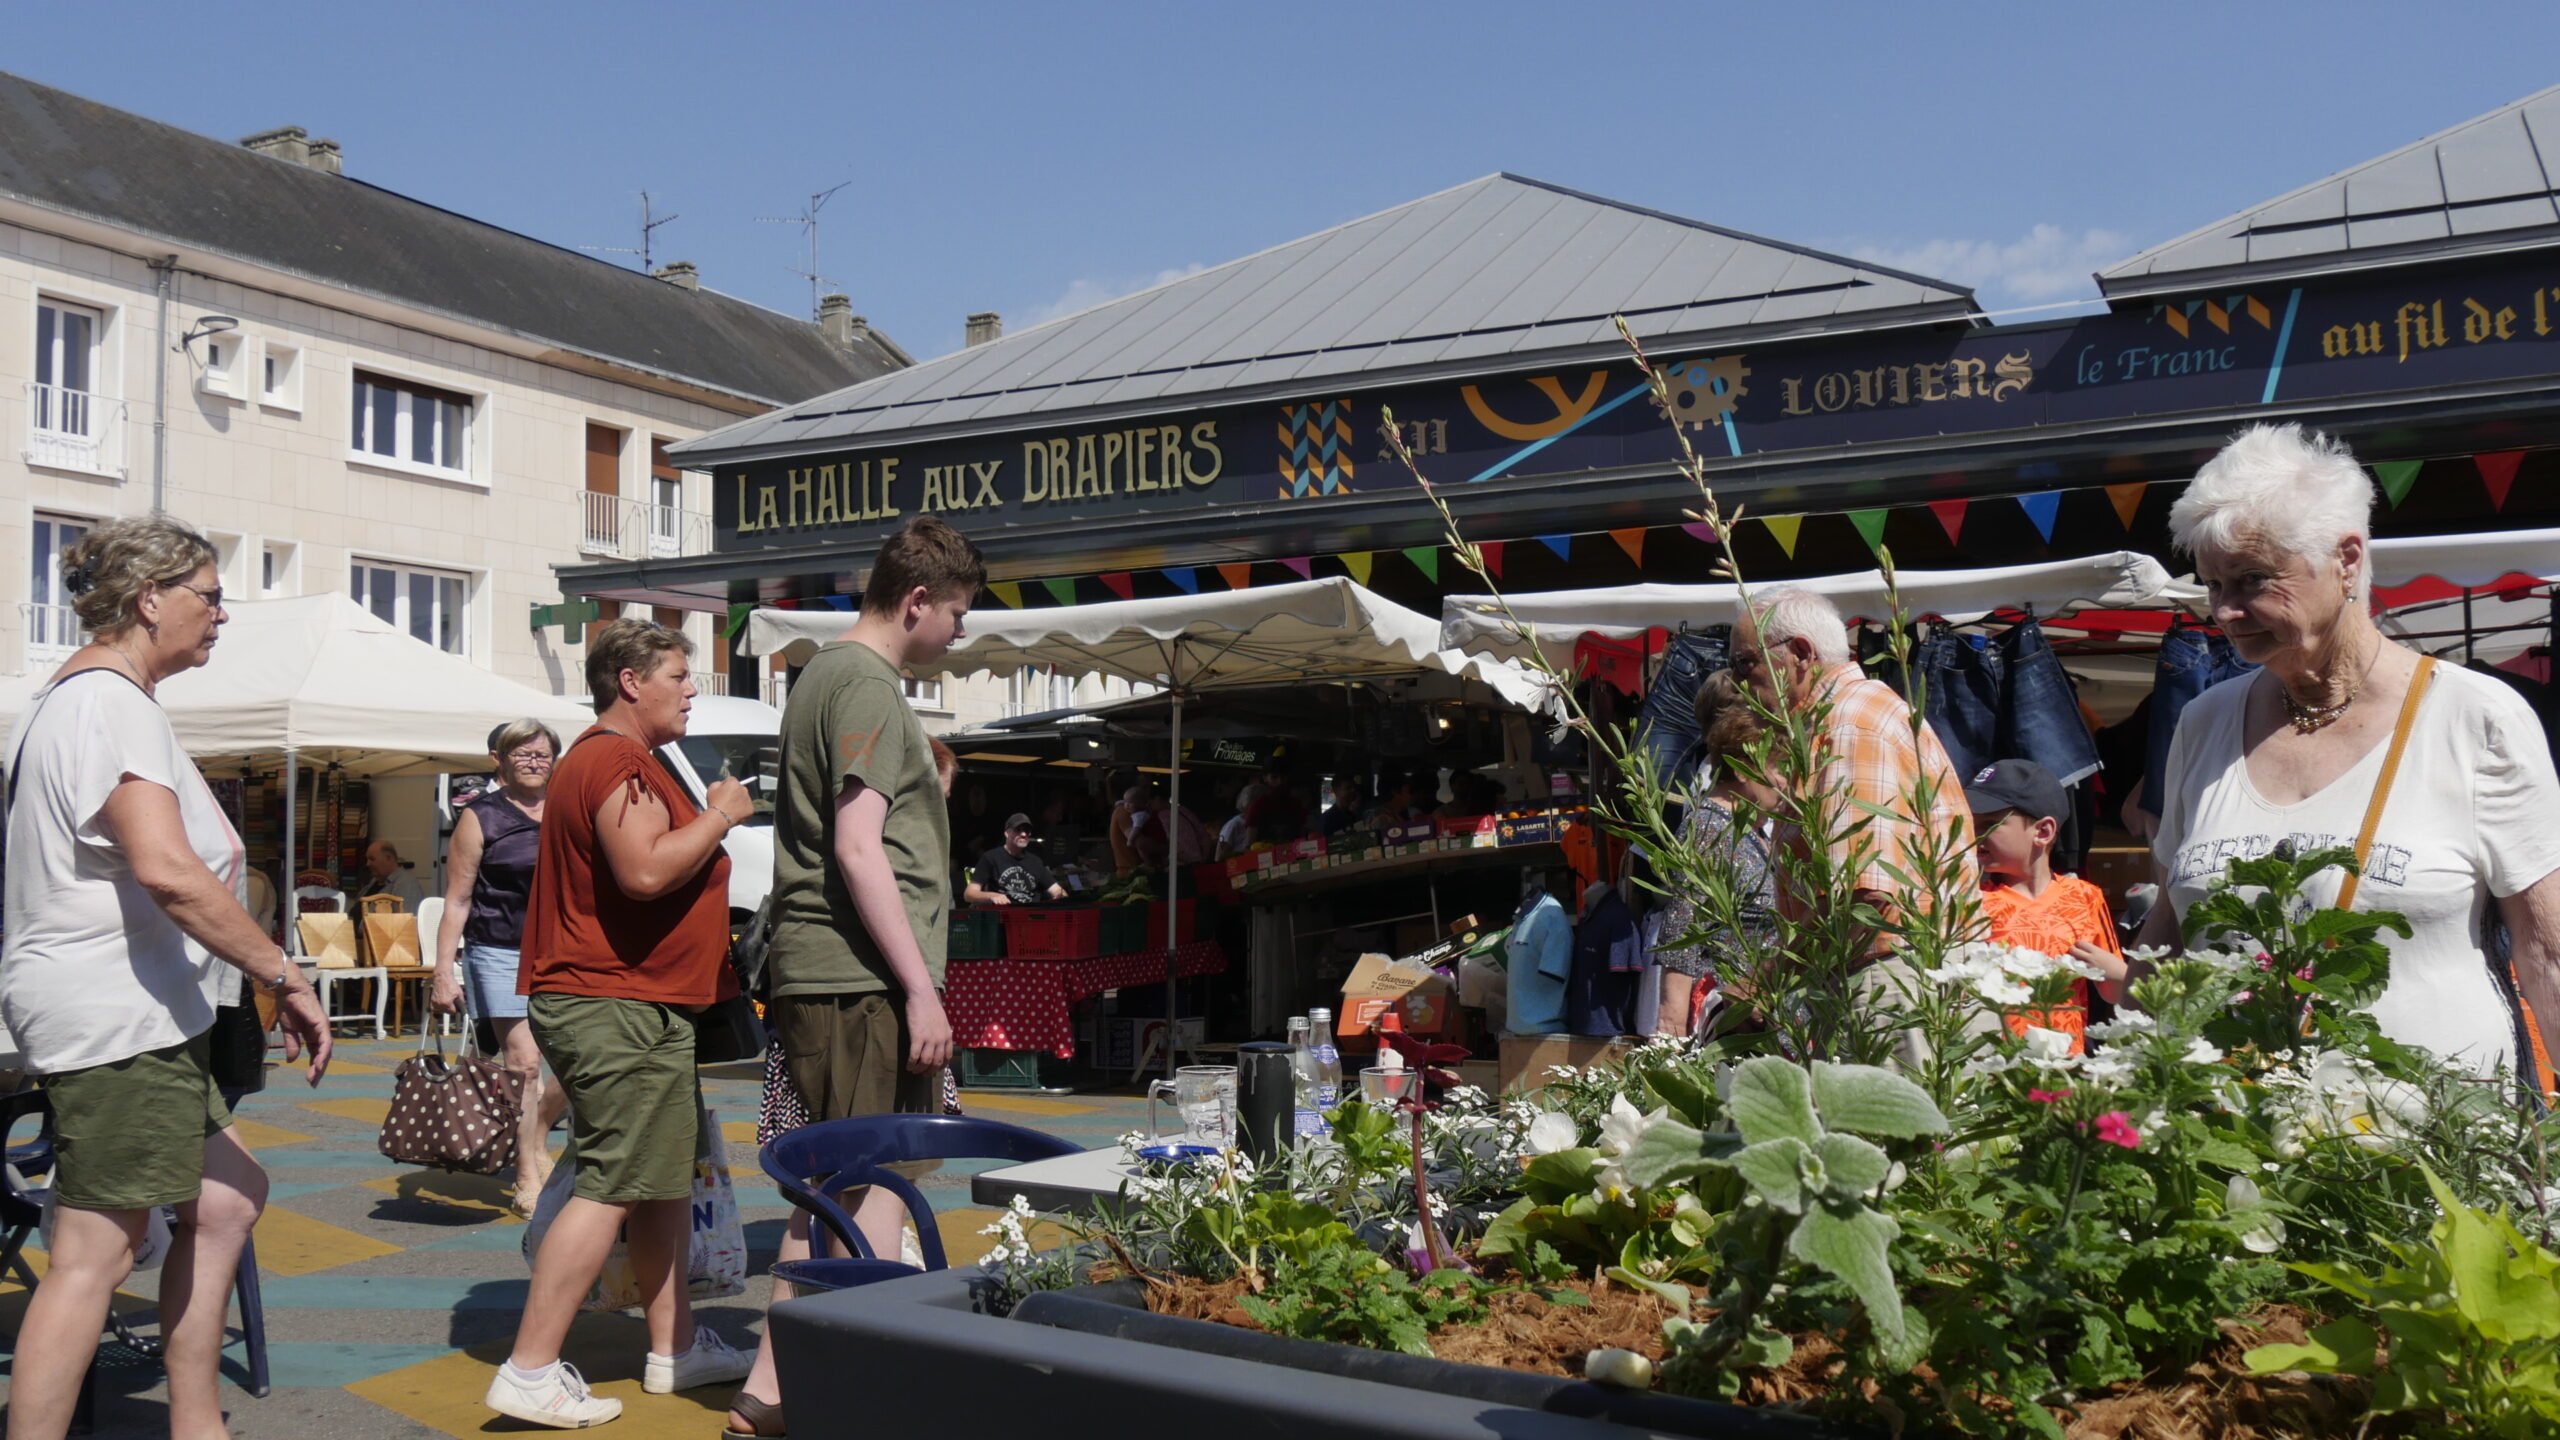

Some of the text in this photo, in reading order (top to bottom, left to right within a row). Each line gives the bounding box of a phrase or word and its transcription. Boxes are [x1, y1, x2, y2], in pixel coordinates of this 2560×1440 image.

[2322, 320, 2384, 358] au
[2394, 299, 2450, 364] fil
[2463, 297, 2517, 344] de
[2077, 344, 2236, 386] le Franc
[787, 457, 900, 528] HALLE
[1022, 420, 1223, 504] DRAPIERS
[1214, 740, 1256, 766] Fromages
